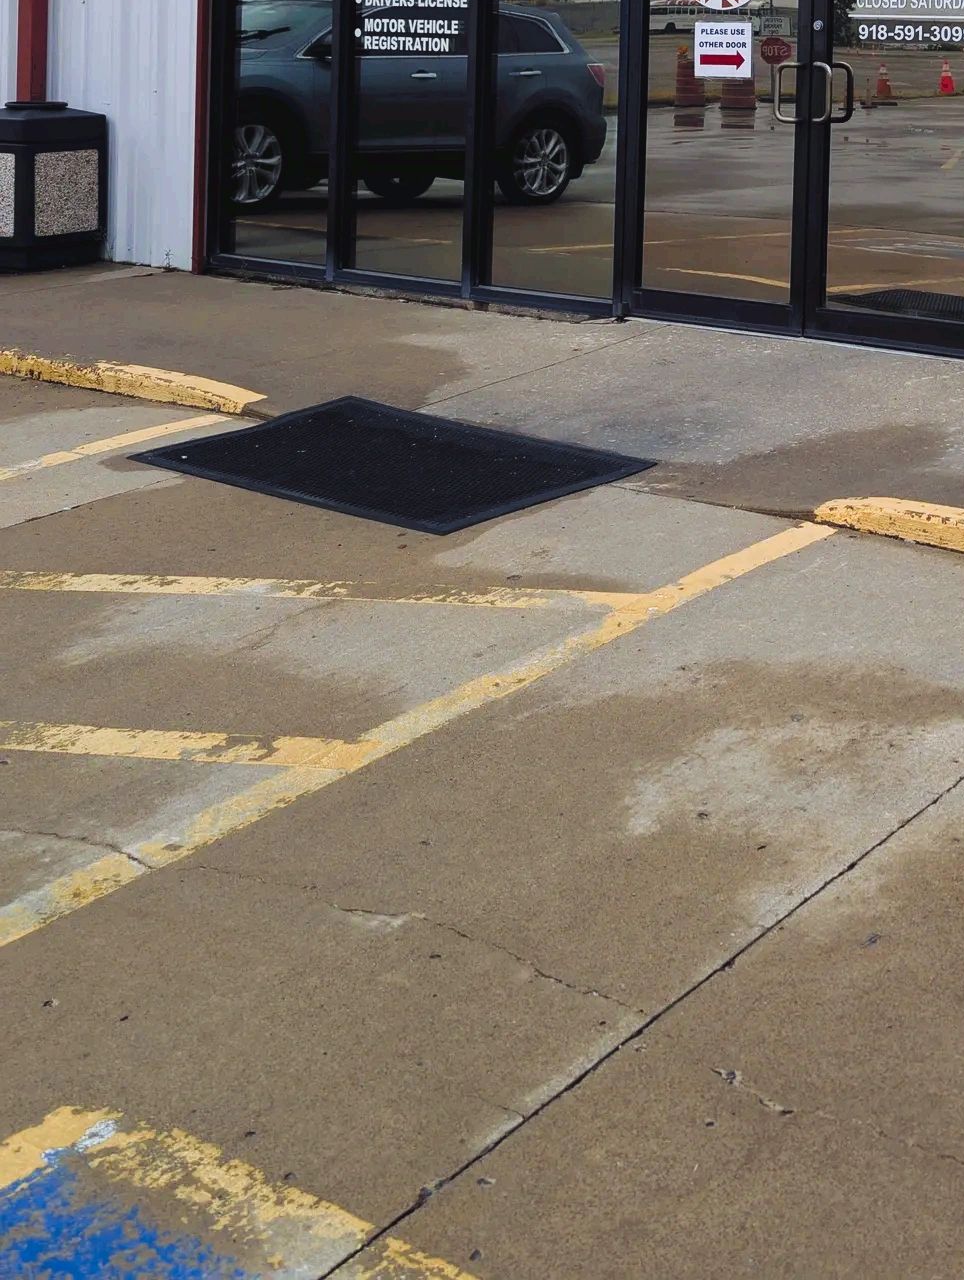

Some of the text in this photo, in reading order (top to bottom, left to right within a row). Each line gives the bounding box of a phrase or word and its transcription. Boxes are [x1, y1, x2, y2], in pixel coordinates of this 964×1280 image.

[364, 18, 459, 35] MOTOR VEHICLE
[700, 28, 746, 36] PLEASE USE
[364, 35, 450, 52] REGISTRATION
[698, 41, 747, 49] OTHER DOOR
